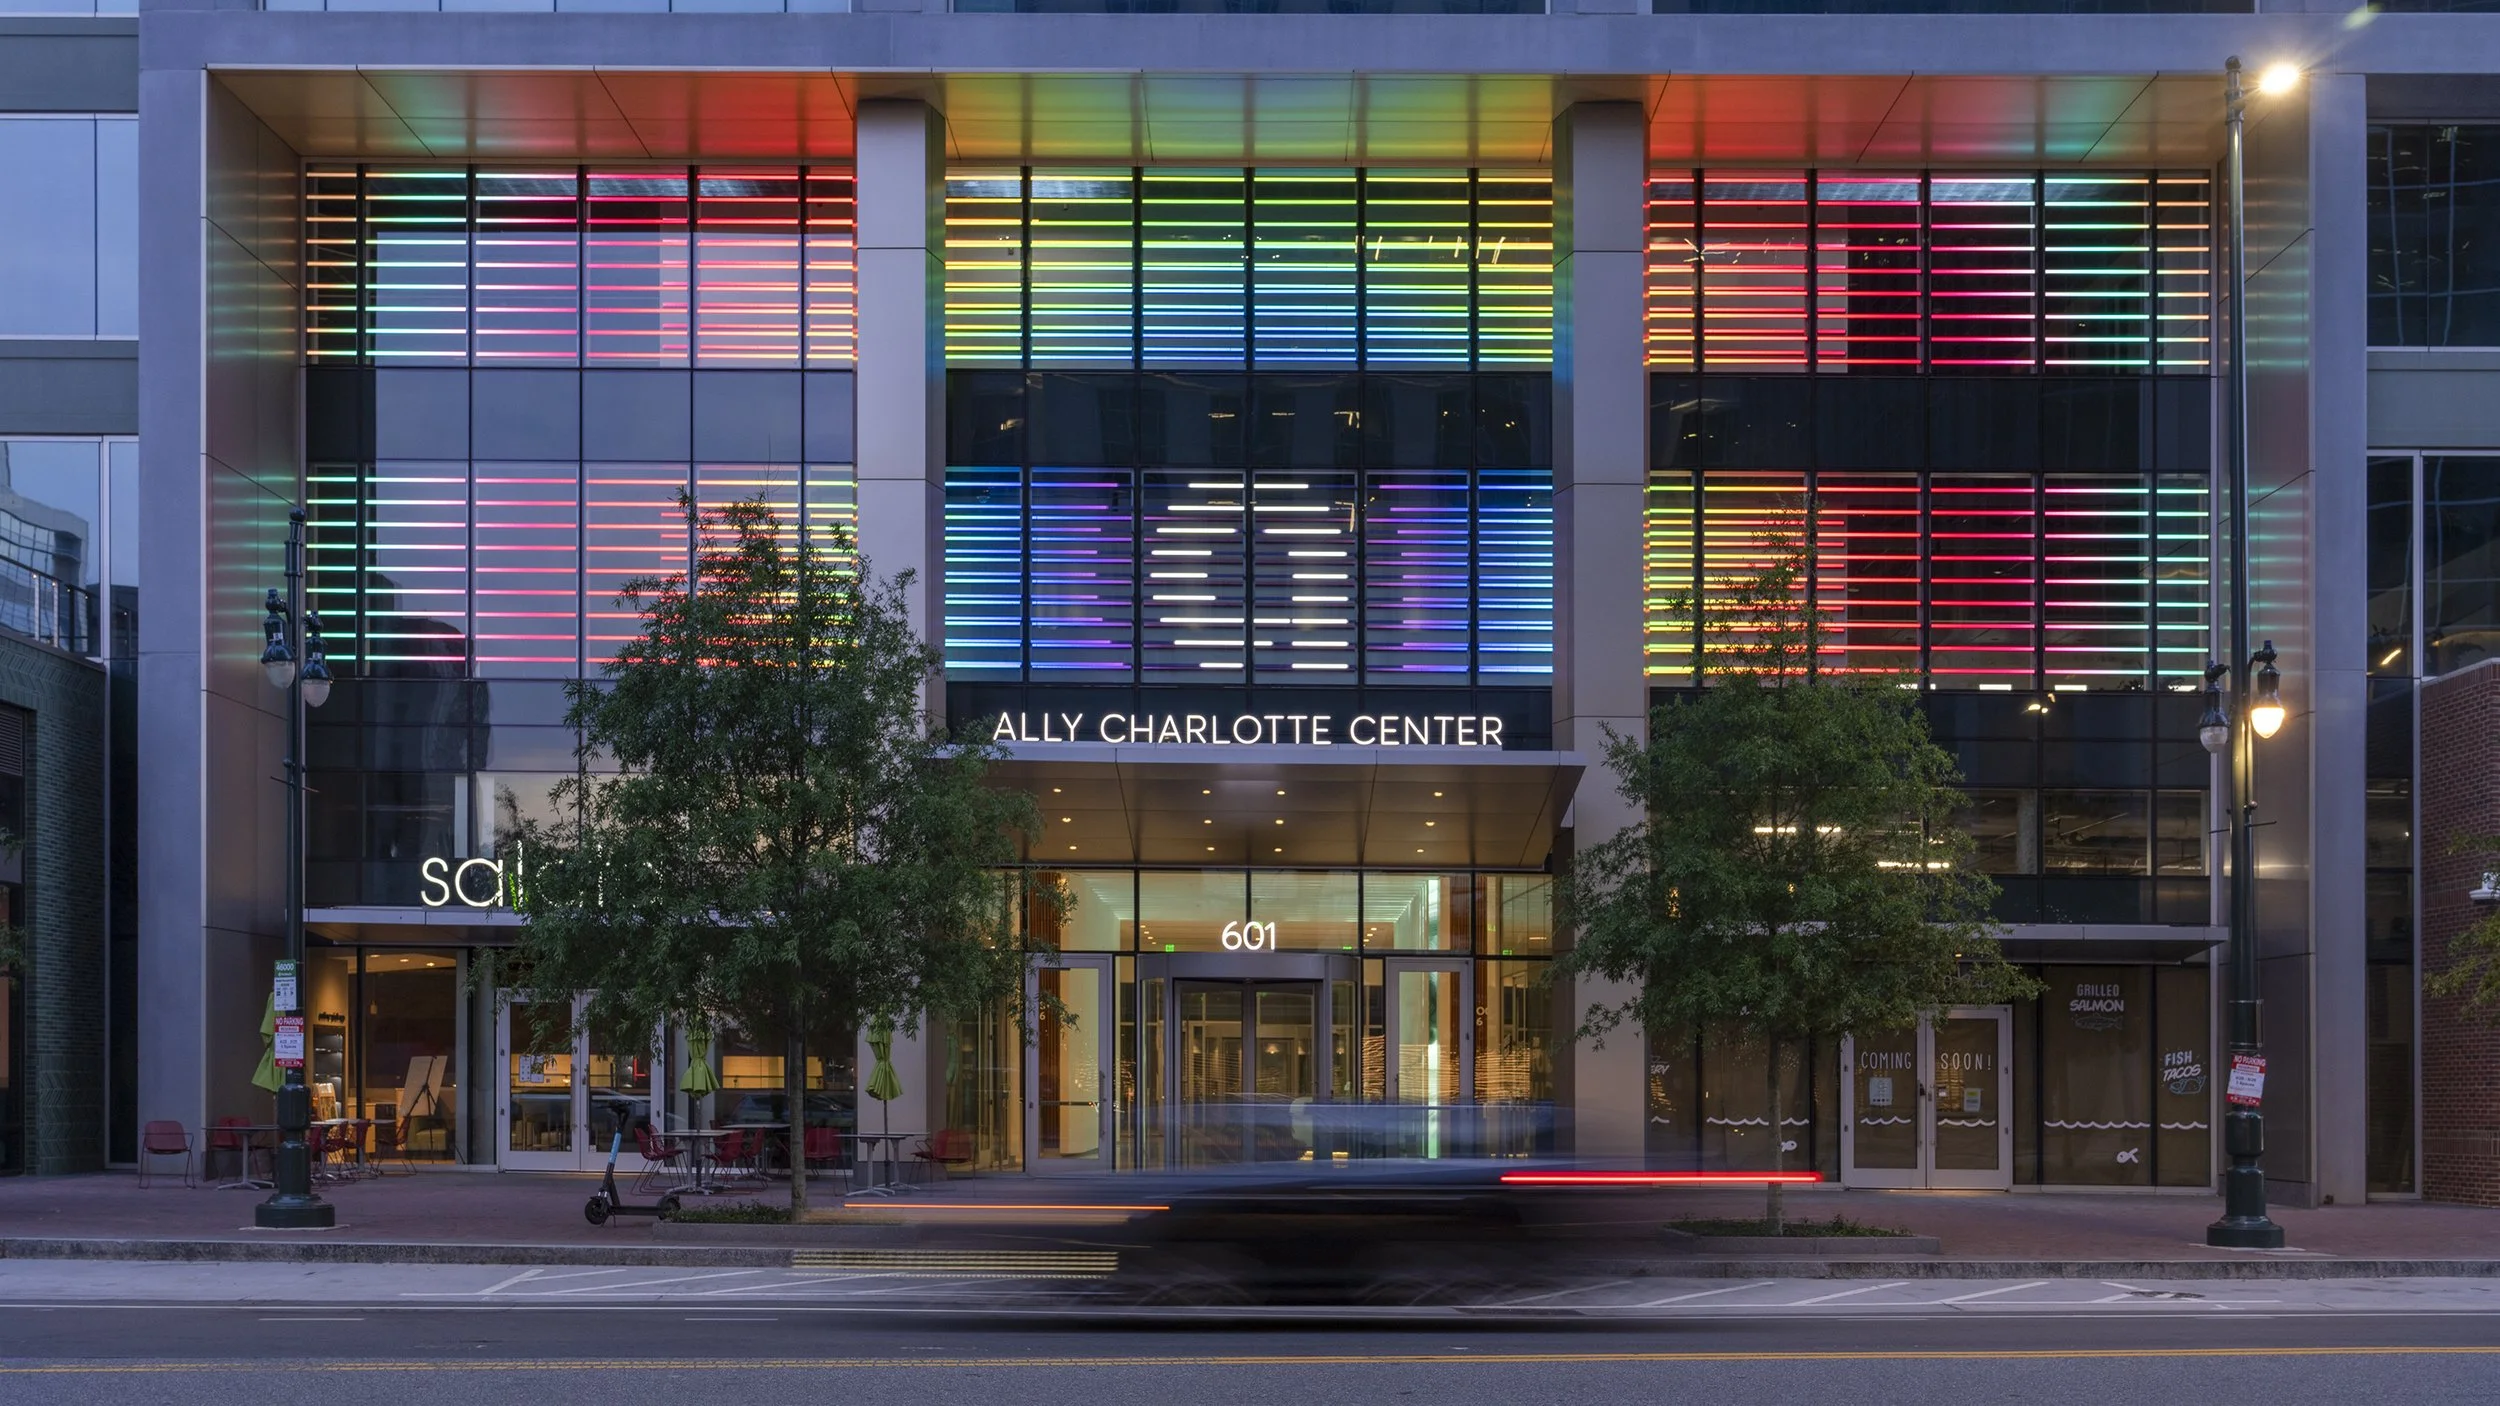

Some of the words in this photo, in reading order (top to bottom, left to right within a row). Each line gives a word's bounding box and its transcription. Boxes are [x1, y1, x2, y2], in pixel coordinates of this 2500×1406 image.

[993, 711, 1083, 743] ALLY
[1100, 713, 1332, 745] CHARLOTTE
[1350, 715, 1503, 746] CENTER
[1221, 921, 1276, 951] 601
[2076, 983, 2120, 997] GRILLED
[2069, 999, 2125, 1012] SALMON
[275, 1016, 283, 1025] NO
[283, 1016, 304, 1025] PARKING
[1861, 1051, 1912, 1070] COMING
[1940, 1052, 1992, 1071] SOON!
[2164, 1050, 2193, 1066] FISH
[2234, 1054, 2243, 1064] NO
[2242, 1056, 2266, 1067] PARKING
[2162, 1064, 2202, 1082] TACOS
